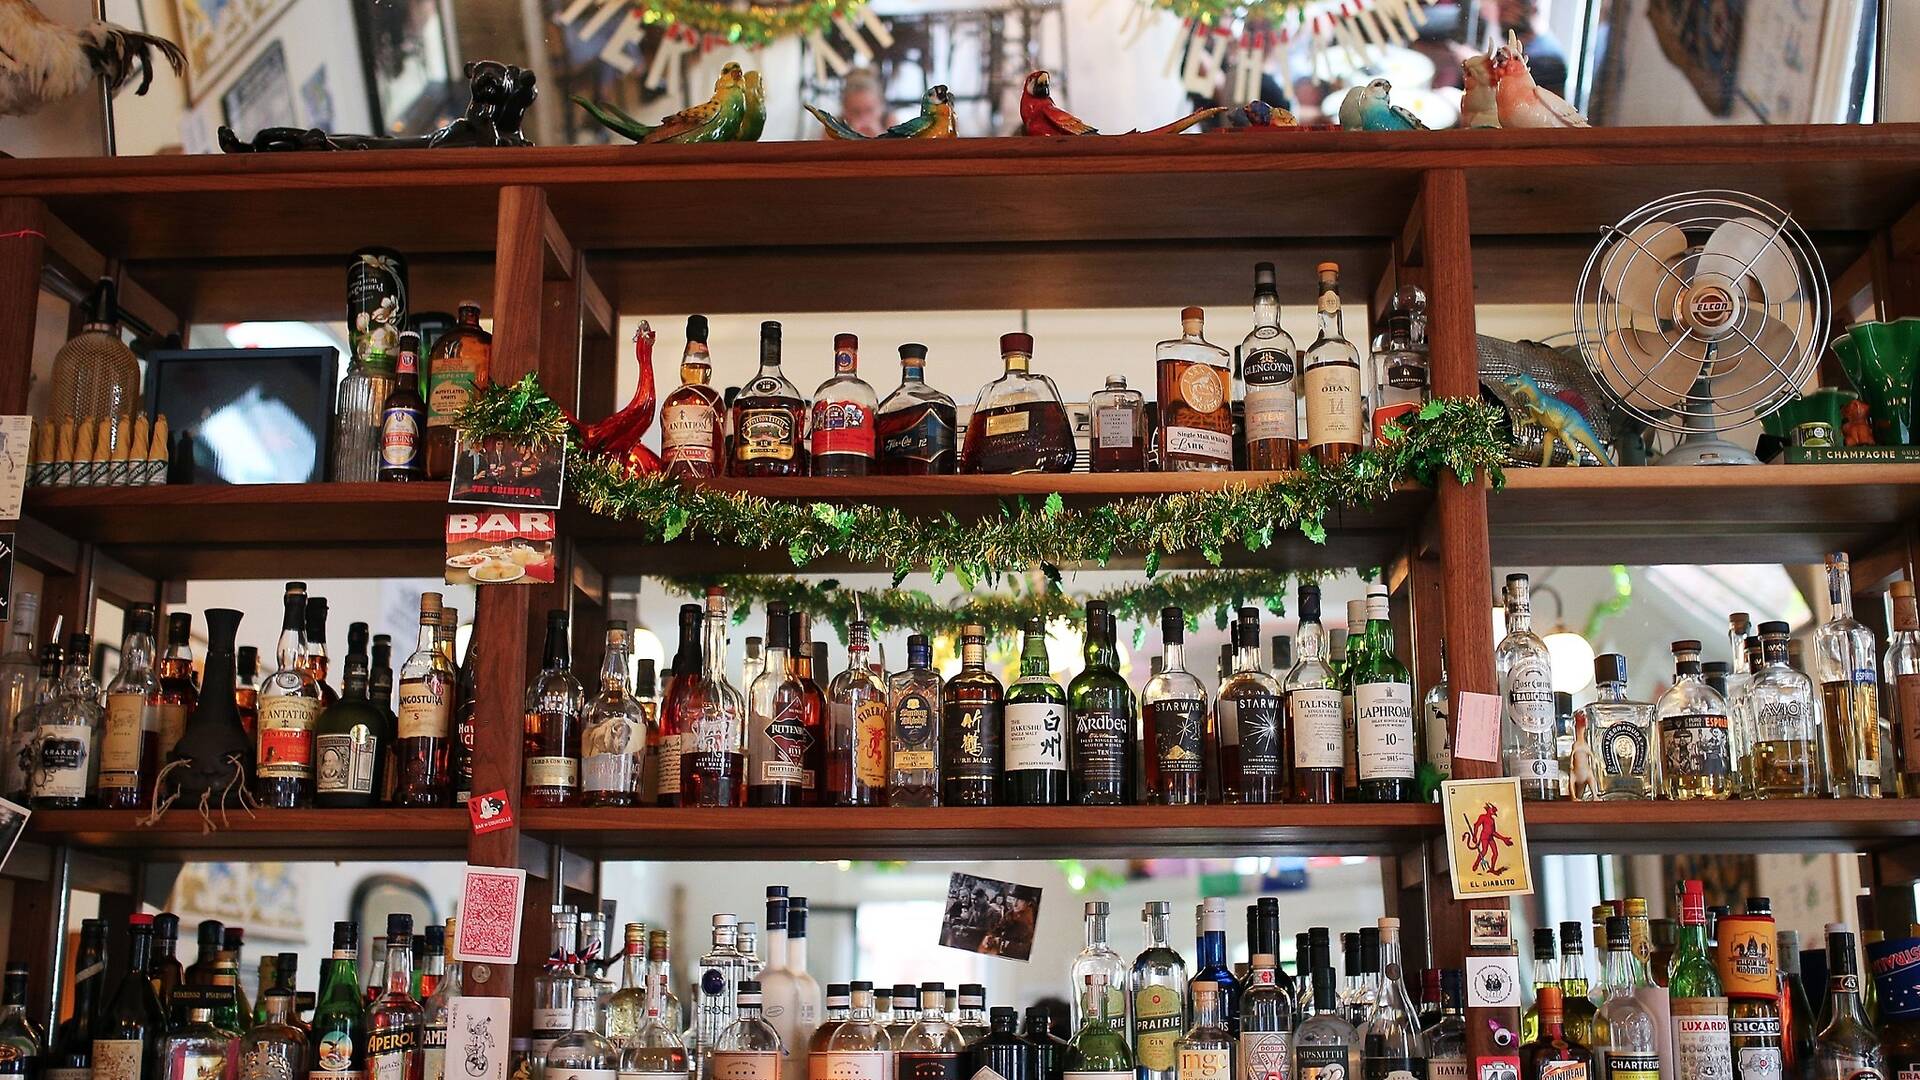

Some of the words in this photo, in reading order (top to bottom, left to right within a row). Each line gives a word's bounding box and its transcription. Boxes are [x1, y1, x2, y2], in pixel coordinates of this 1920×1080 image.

[1696, 302, 1728, 311] ELCON
[1244, 362, 1294, 376] GLENGOYNE
[1328, 398, 1346, 415] 14
[384, 434, 413, 444] VERGINA
[1177, 430, 1196, 439] Single
[1210, 435, 1228, 445] Whisky
[1826, 450, 1896, 459] CHAMPAGNE
[448, 512, 553, 534] BAR
[400, 695, 444, 706] ANGOSTURA
[1239, 699, 1280, 709] STARWA
[1155, 702, 1201, 712] STARWAR
[1762, 700, 1812, 717] AVIÓN
[261, 709, 314, 720] LANTATION
[1076, 713, 1127, 735] Ardbeg
[1040, 708, 1062, 762] 白州
[1606, 725, 1642, 742] HERRADURA
[1385, 733, 1396, 746] 10
[1326, 742, 1335, 752] 10
[1470, 880, 1480, 888] EL
[1482, 879, 1515, 887] DIABLITO
[1845, 978, 1857, 988] 43
[1137, 1016, 1181, 1030] PRAIRIE
[1682, 1020, 1728, 1031] LUXARDO
[1733, 1021, 1780, 1031] RICARD
[368, 1032, 416, 1054] APEROL
[1299, 1050, 1344, 1059] SIPSMITH
[1900, 1072, 1920, 1080] DRA
